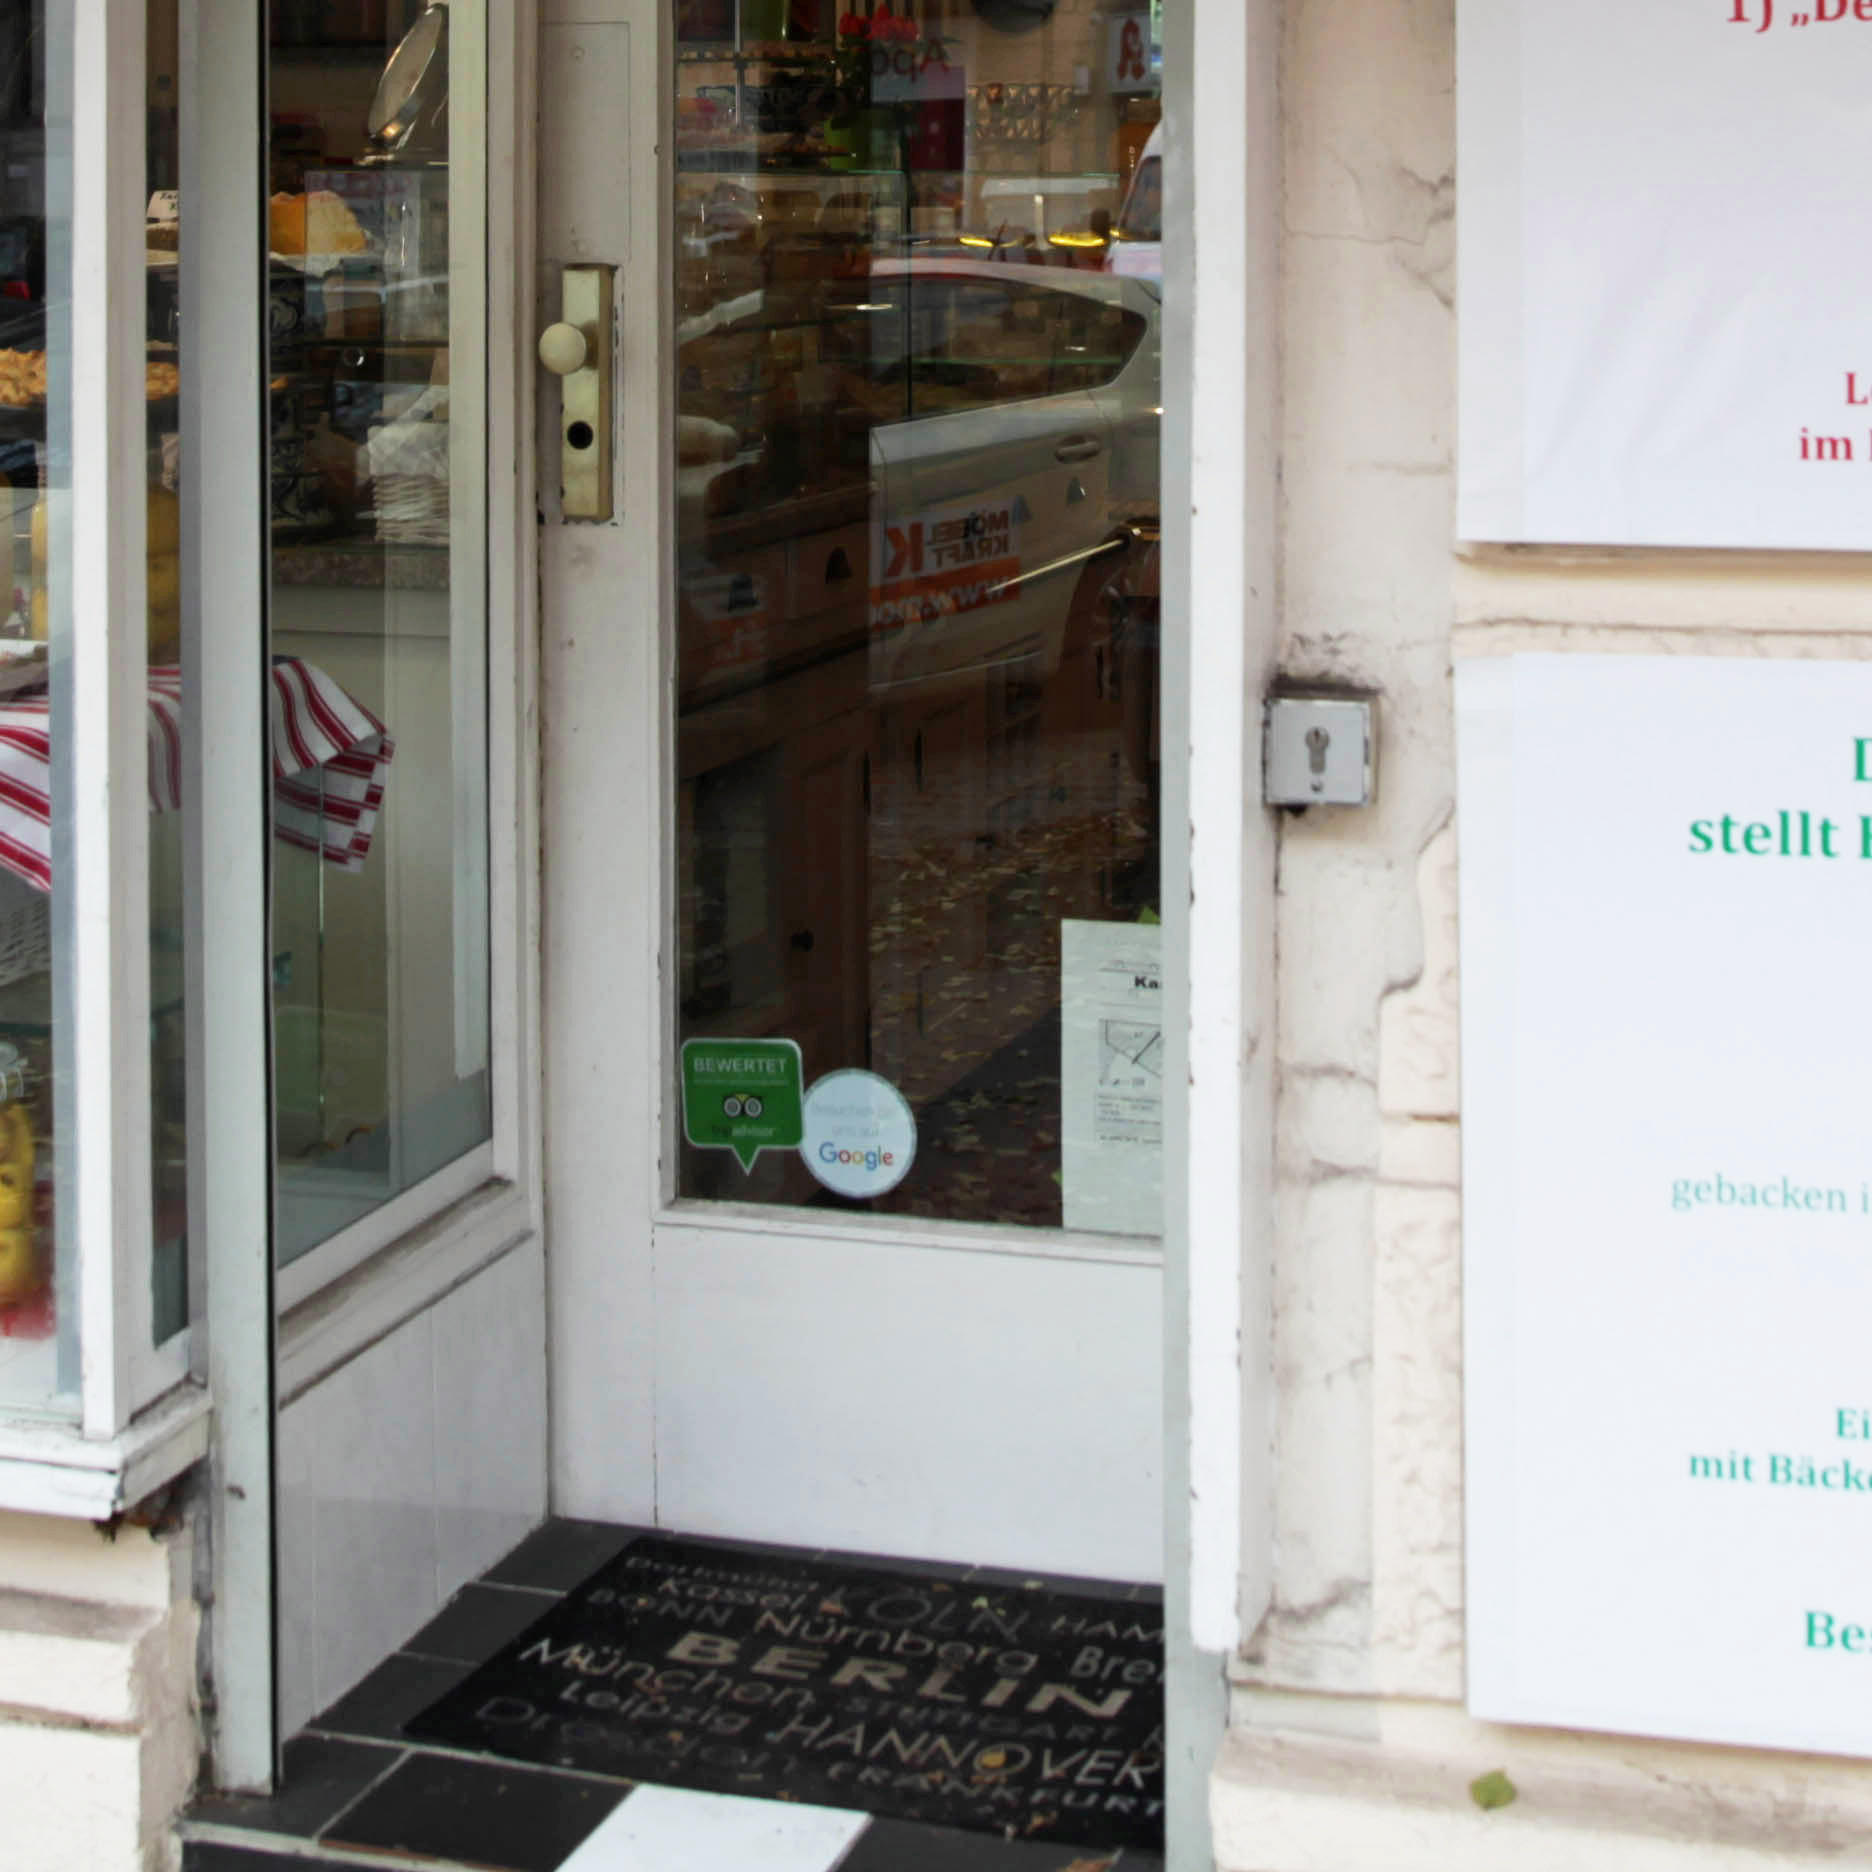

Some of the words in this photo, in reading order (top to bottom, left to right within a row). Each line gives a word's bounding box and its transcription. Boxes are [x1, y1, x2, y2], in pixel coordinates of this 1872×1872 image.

[1799, 427, 1853, 461] im
[1689, 811, 1837, 858] stellt
[692, 1055, 789, 1075] BEWERTET
[818, 1140, 895, 1173] Google
[1670, 1171, 1847, 1213] gebacken
[1688, 1454, 1752, 1482] mit
[665, 1629, 1134, 1720] BERLIN
[765, 1713, 1162, 1790] HANNOVER
